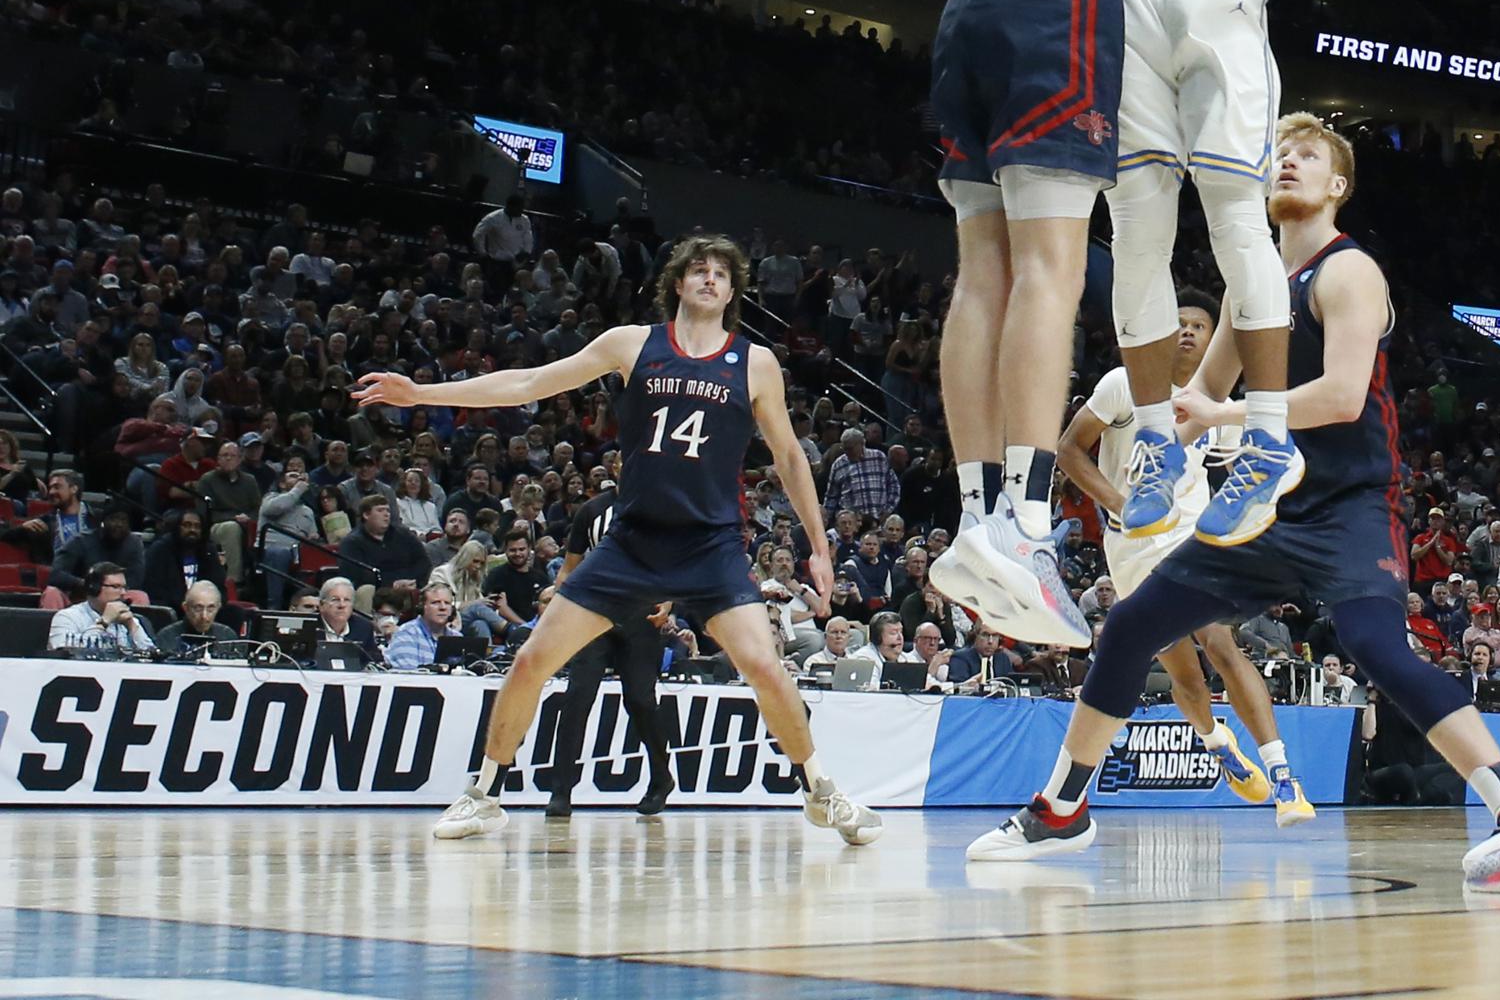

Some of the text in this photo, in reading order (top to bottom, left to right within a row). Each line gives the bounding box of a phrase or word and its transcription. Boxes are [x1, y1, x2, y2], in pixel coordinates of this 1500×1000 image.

[1315, 32, 1389, 64] FIRST
[1392, 46, 1442, 72] AND
[498, 132, 537, 152] MARCH
[646, 377, 731, 404] SAINT MARY'S
[647, 406, 710, 458] 14
[17, 676, 446, 793] SECOND
[1128, 725, 1194, 752] MARCH
[1138, 752, 1221, 779] MADNESS
